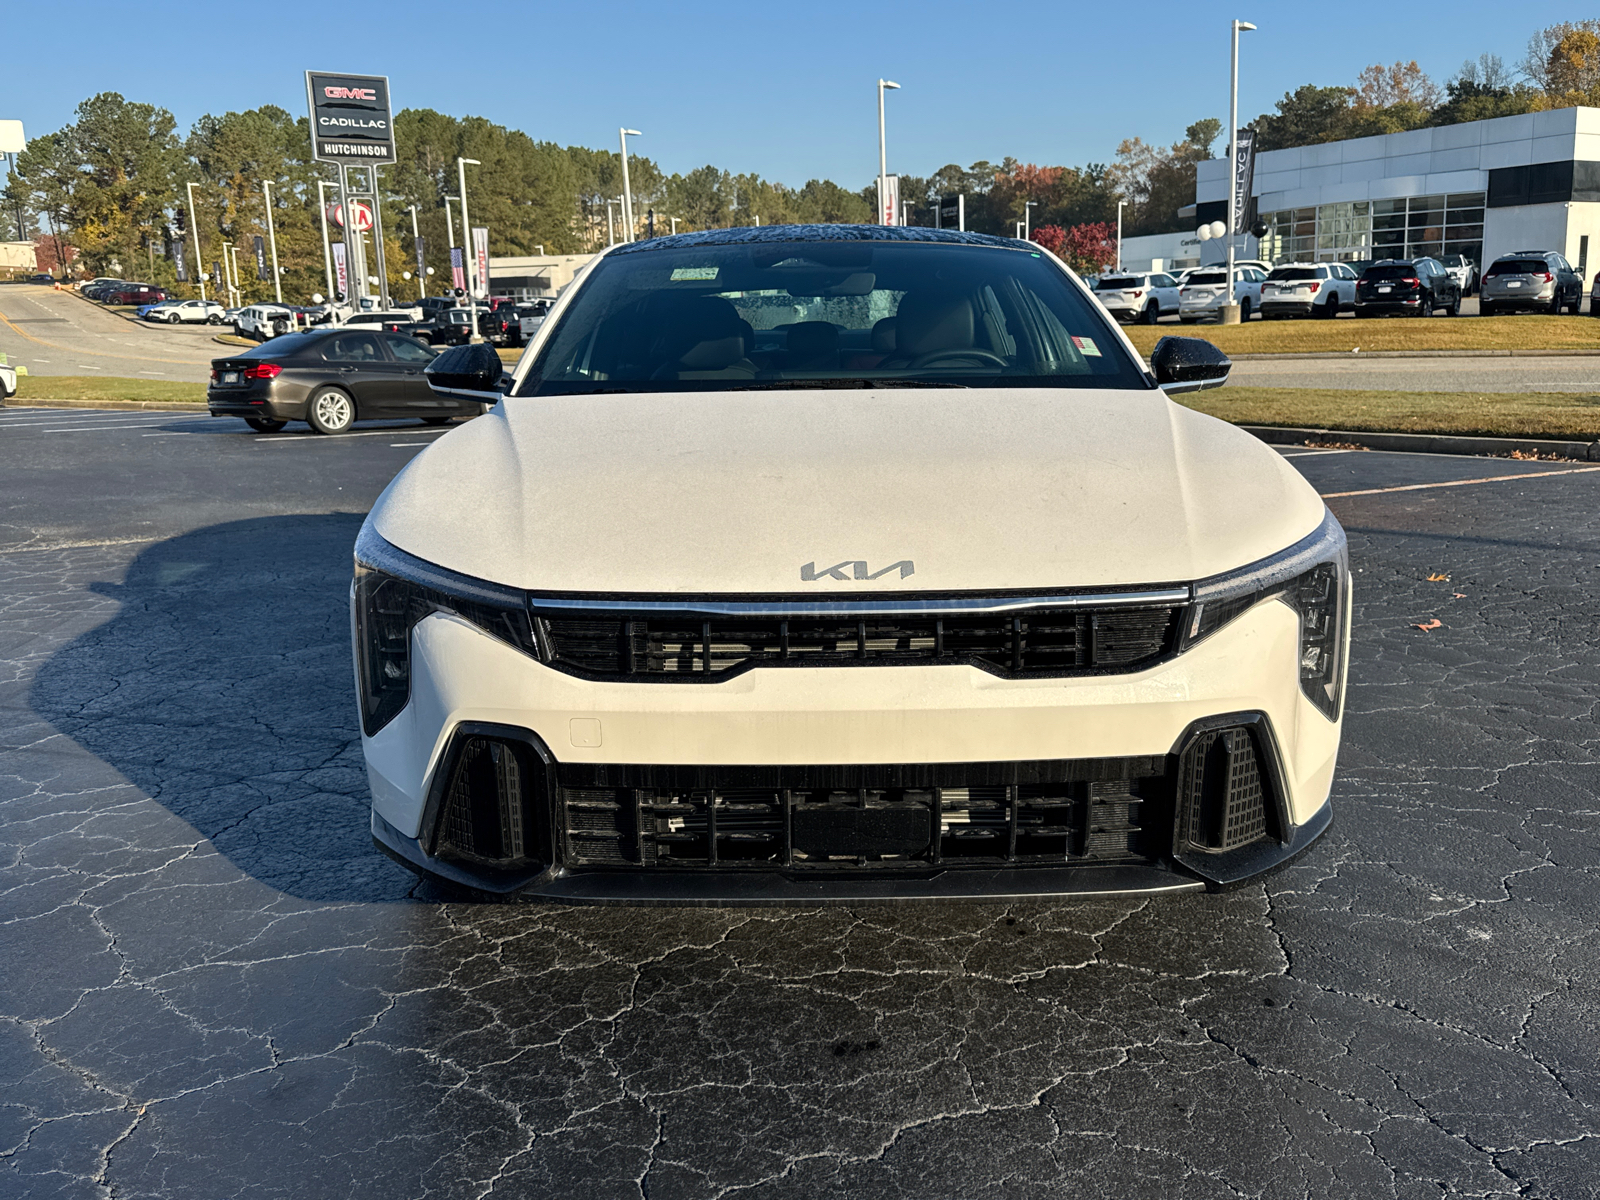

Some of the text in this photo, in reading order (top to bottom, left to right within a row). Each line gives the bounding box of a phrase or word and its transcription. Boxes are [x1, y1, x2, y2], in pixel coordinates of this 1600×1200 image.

[324, 86, 376, 100] GMC
[319, 117, 387, 128] CADILLAC
[324, 143, 388, 156] HUTCHINSON
[800, 560, 915, 581] KIA
